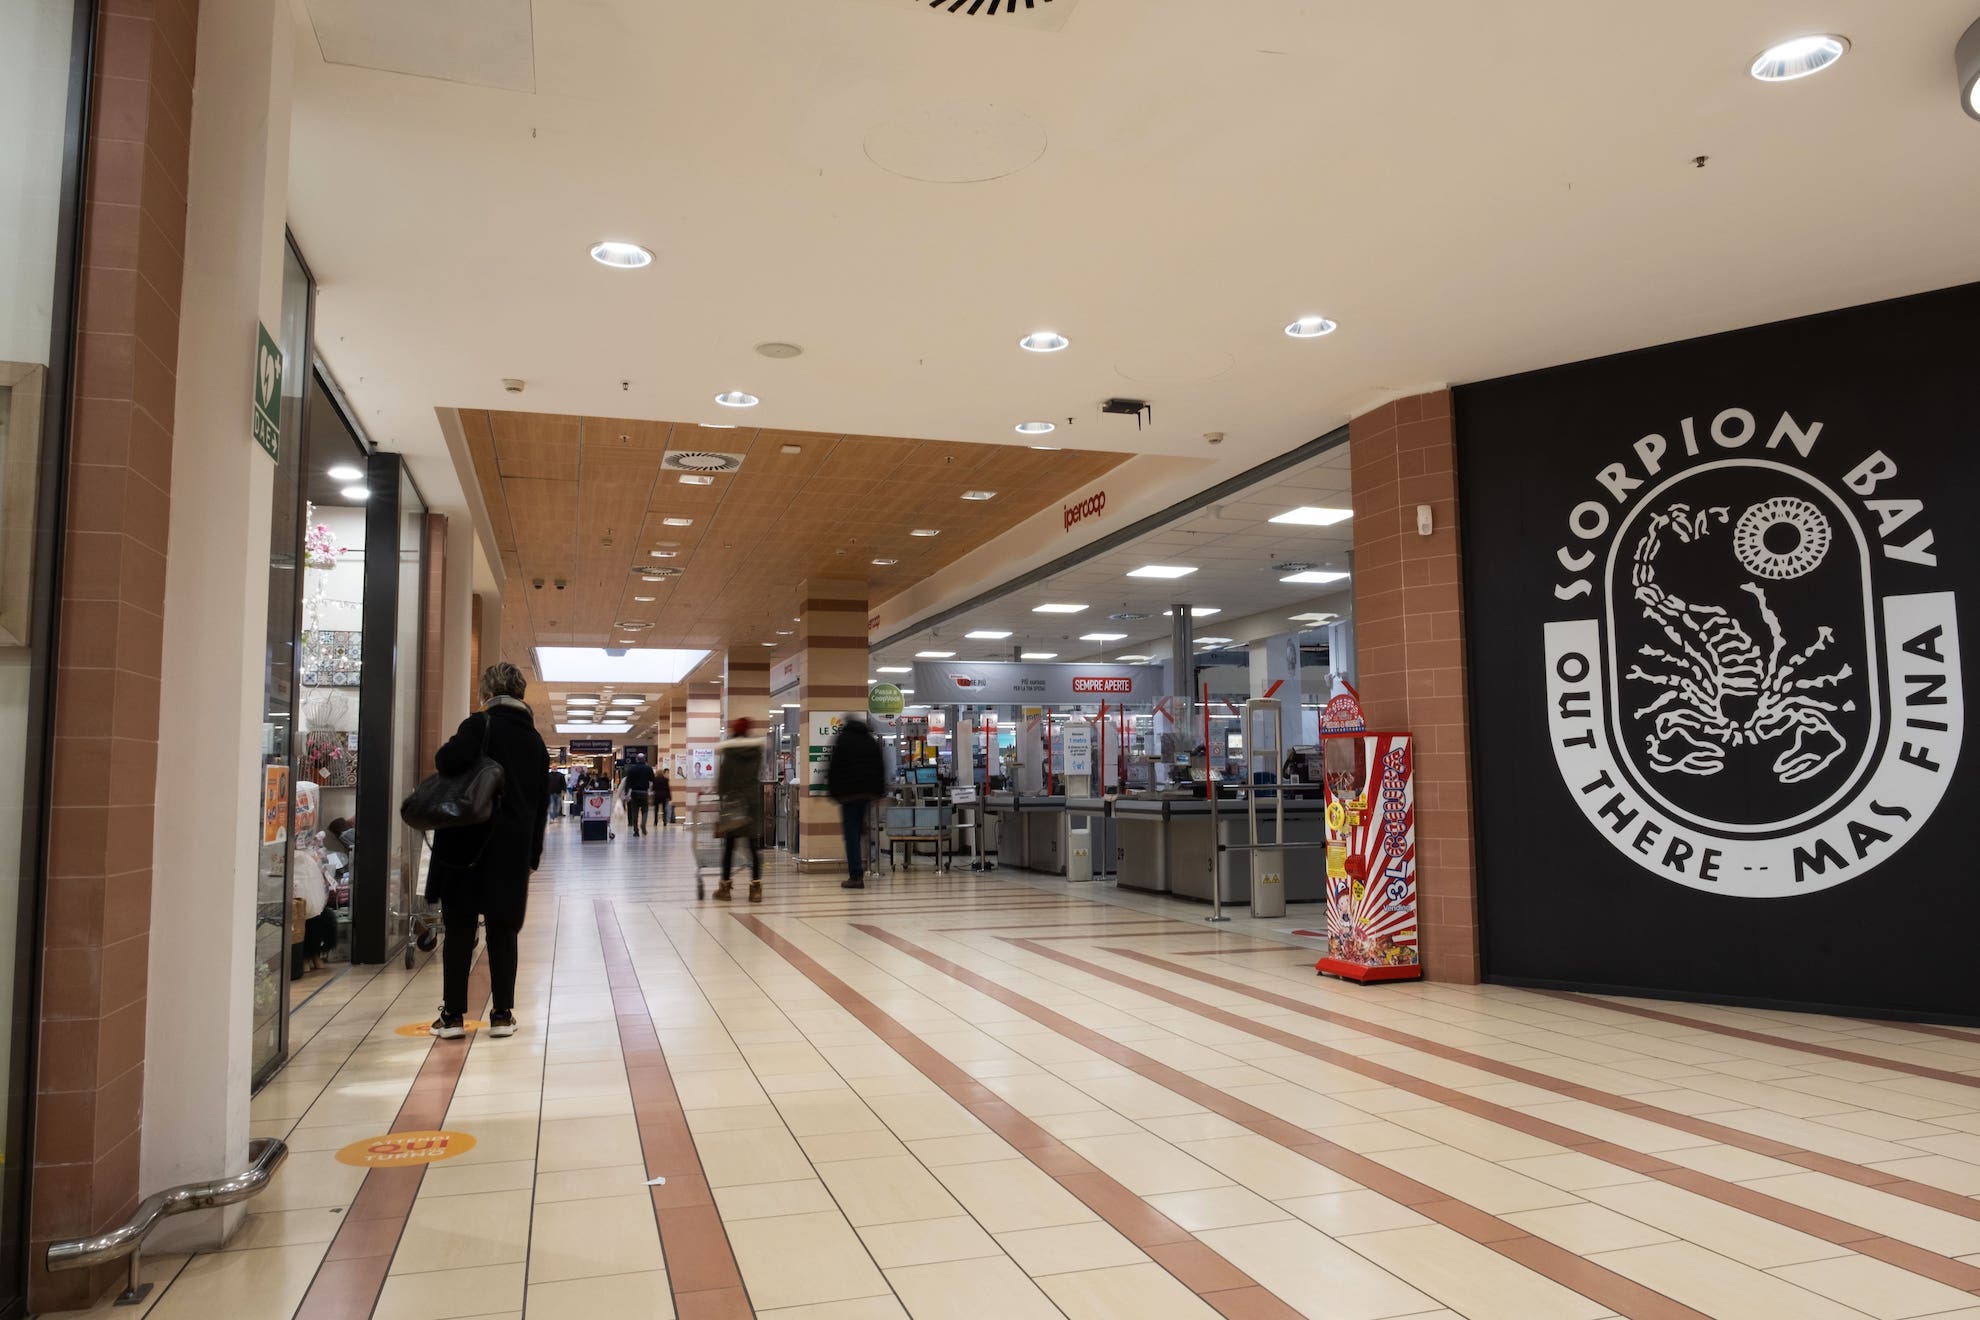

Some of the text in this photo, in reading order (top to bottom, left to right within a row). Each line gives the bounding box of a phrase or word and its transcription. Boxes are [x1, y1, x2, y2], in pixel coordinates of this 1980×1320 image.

[254, 411, 271, 449] DAE
[1064, 491, 1106, 533] ipercoop
[1554, 408, 1938, 600] SCORPION BAY
[1074, 679, 1130, 691] SEMPRE APERTE
[819, 727, 830, 735] LE
[1556, 652, 1597, 749] OUT
[1581, 769, 1723, 882] THERE
[1792, 800, 1912, 882] MAS
[1899, 624, 1949, 773] FINA
[1382, 747, 1408, 858] CHUPA
[368, 1140, 449, 1154] QUI
